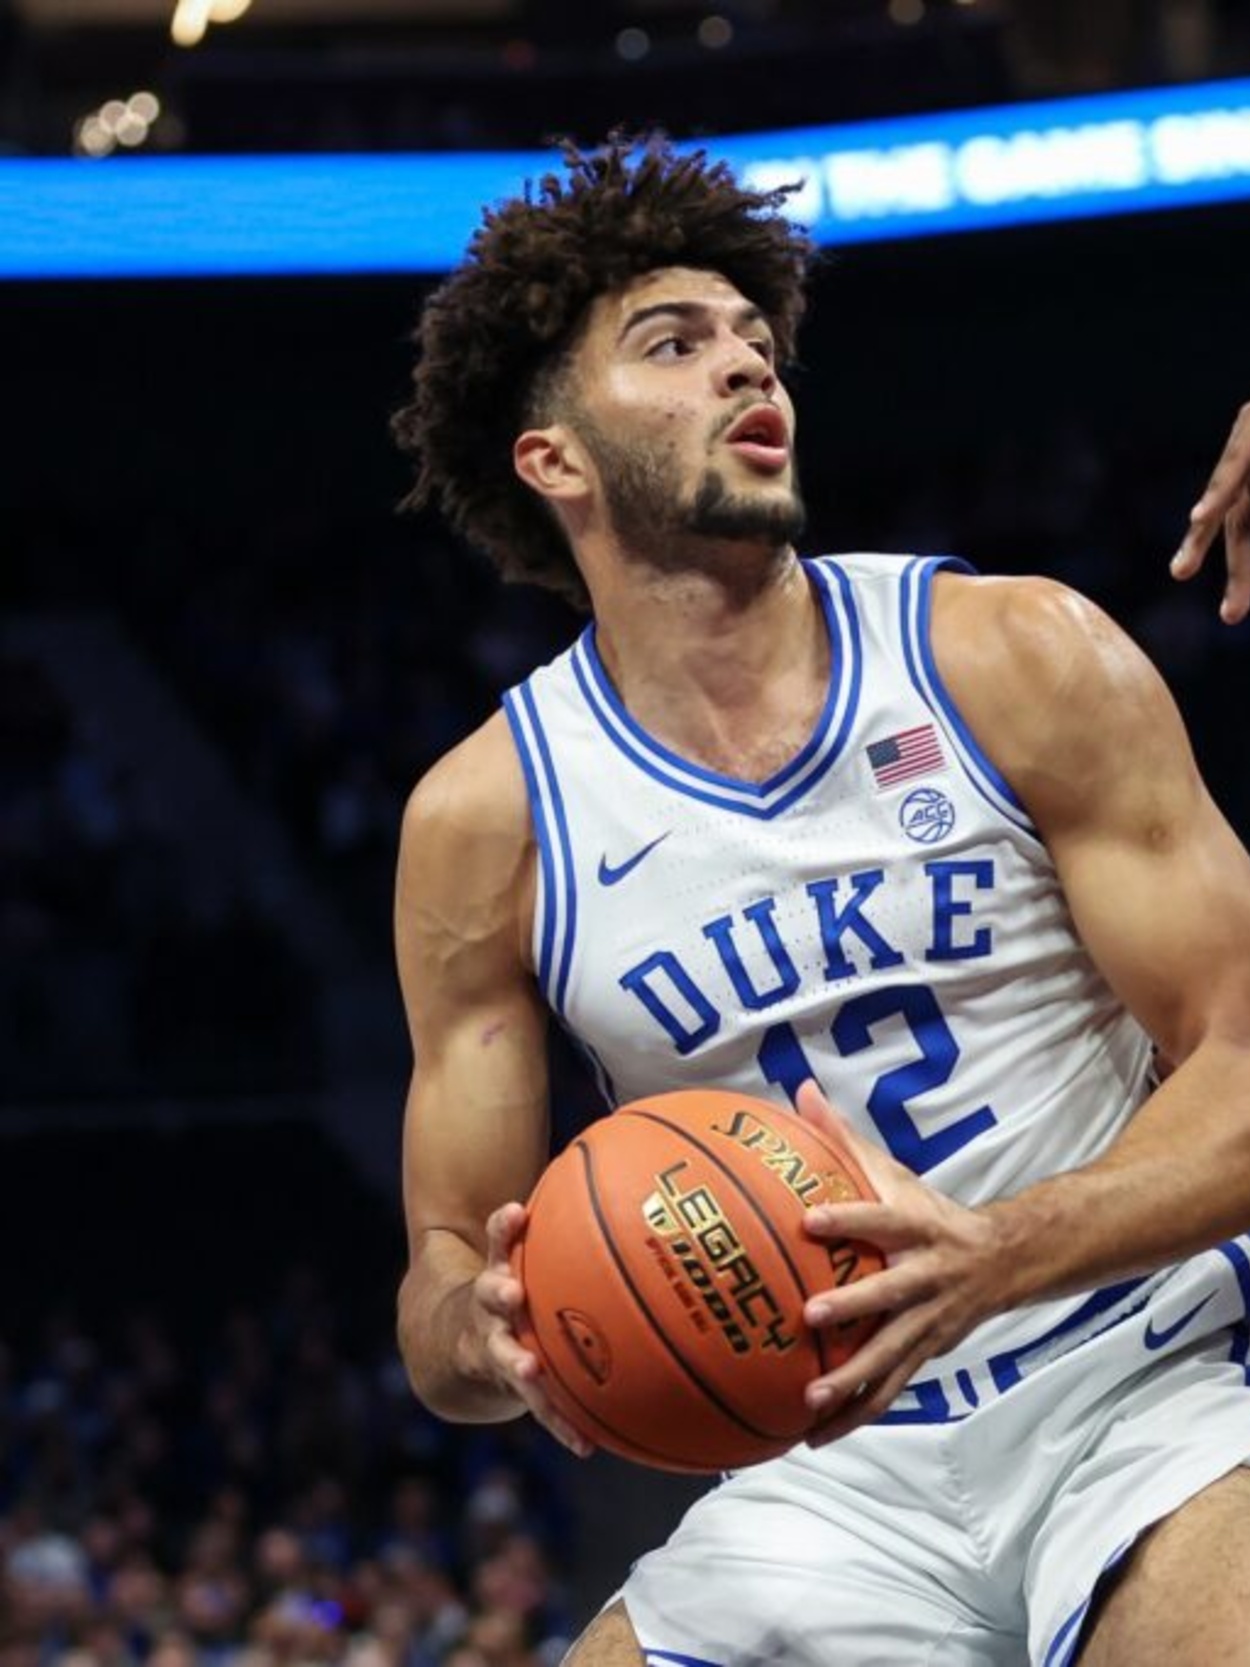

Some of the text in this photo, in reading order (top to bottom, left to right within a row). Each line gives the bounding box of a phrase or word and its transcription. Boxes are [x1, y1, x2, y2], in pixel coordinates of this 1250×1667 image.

[823, 142, 953, 219] THE
[953, 119, 1145, 204] GAME
[619, 859, 995, 1055] DUKE
[757, 983, 998, 1175] 12
[655, 1159, 798, 1353] LEGACY
